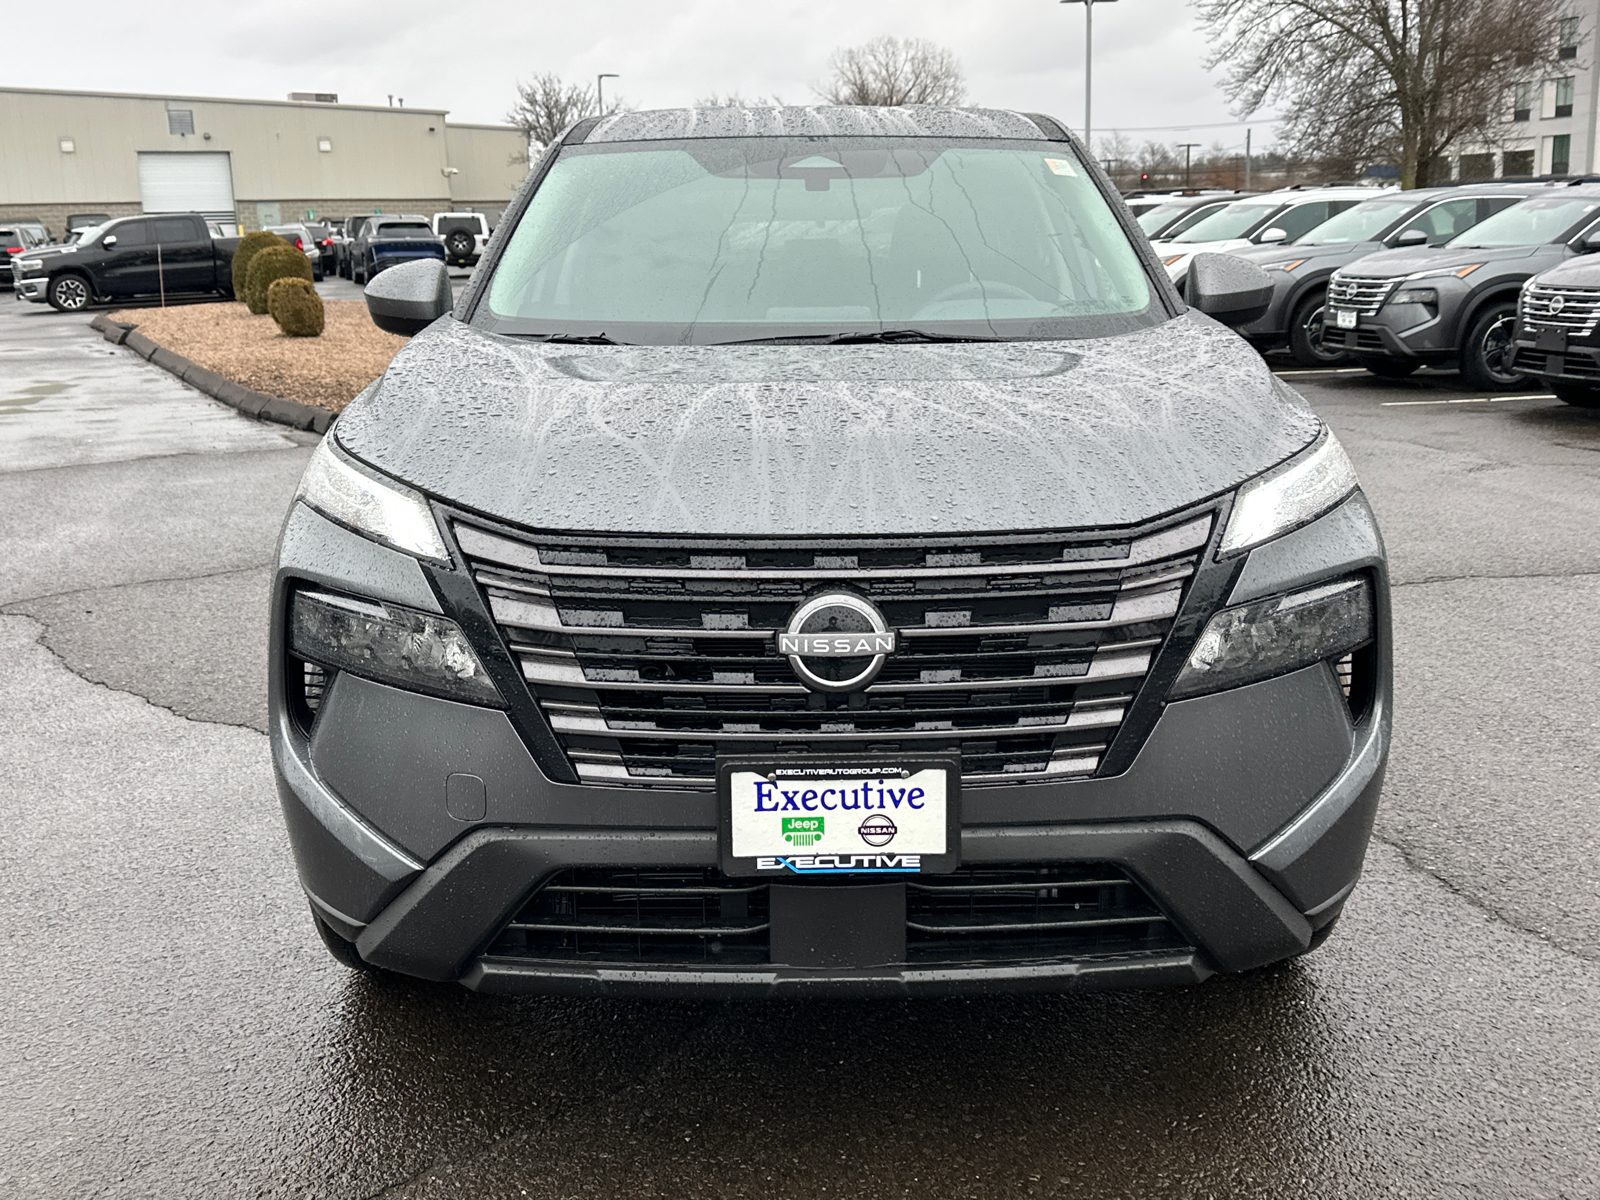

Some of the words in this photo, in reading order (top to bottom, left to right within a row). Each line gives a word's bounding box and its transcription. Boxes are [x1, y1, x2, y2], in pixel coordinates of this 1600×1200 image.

[782, 637, 892, 653] NISSAN
[775, 767, 902, 776] EXECUTIVEAUTOGROUP.COM
[754, 779, 925, 812] Executive
[787, 819, 819, 830] Jeep
[756, 855, 921, 871] EXECUTIVE
